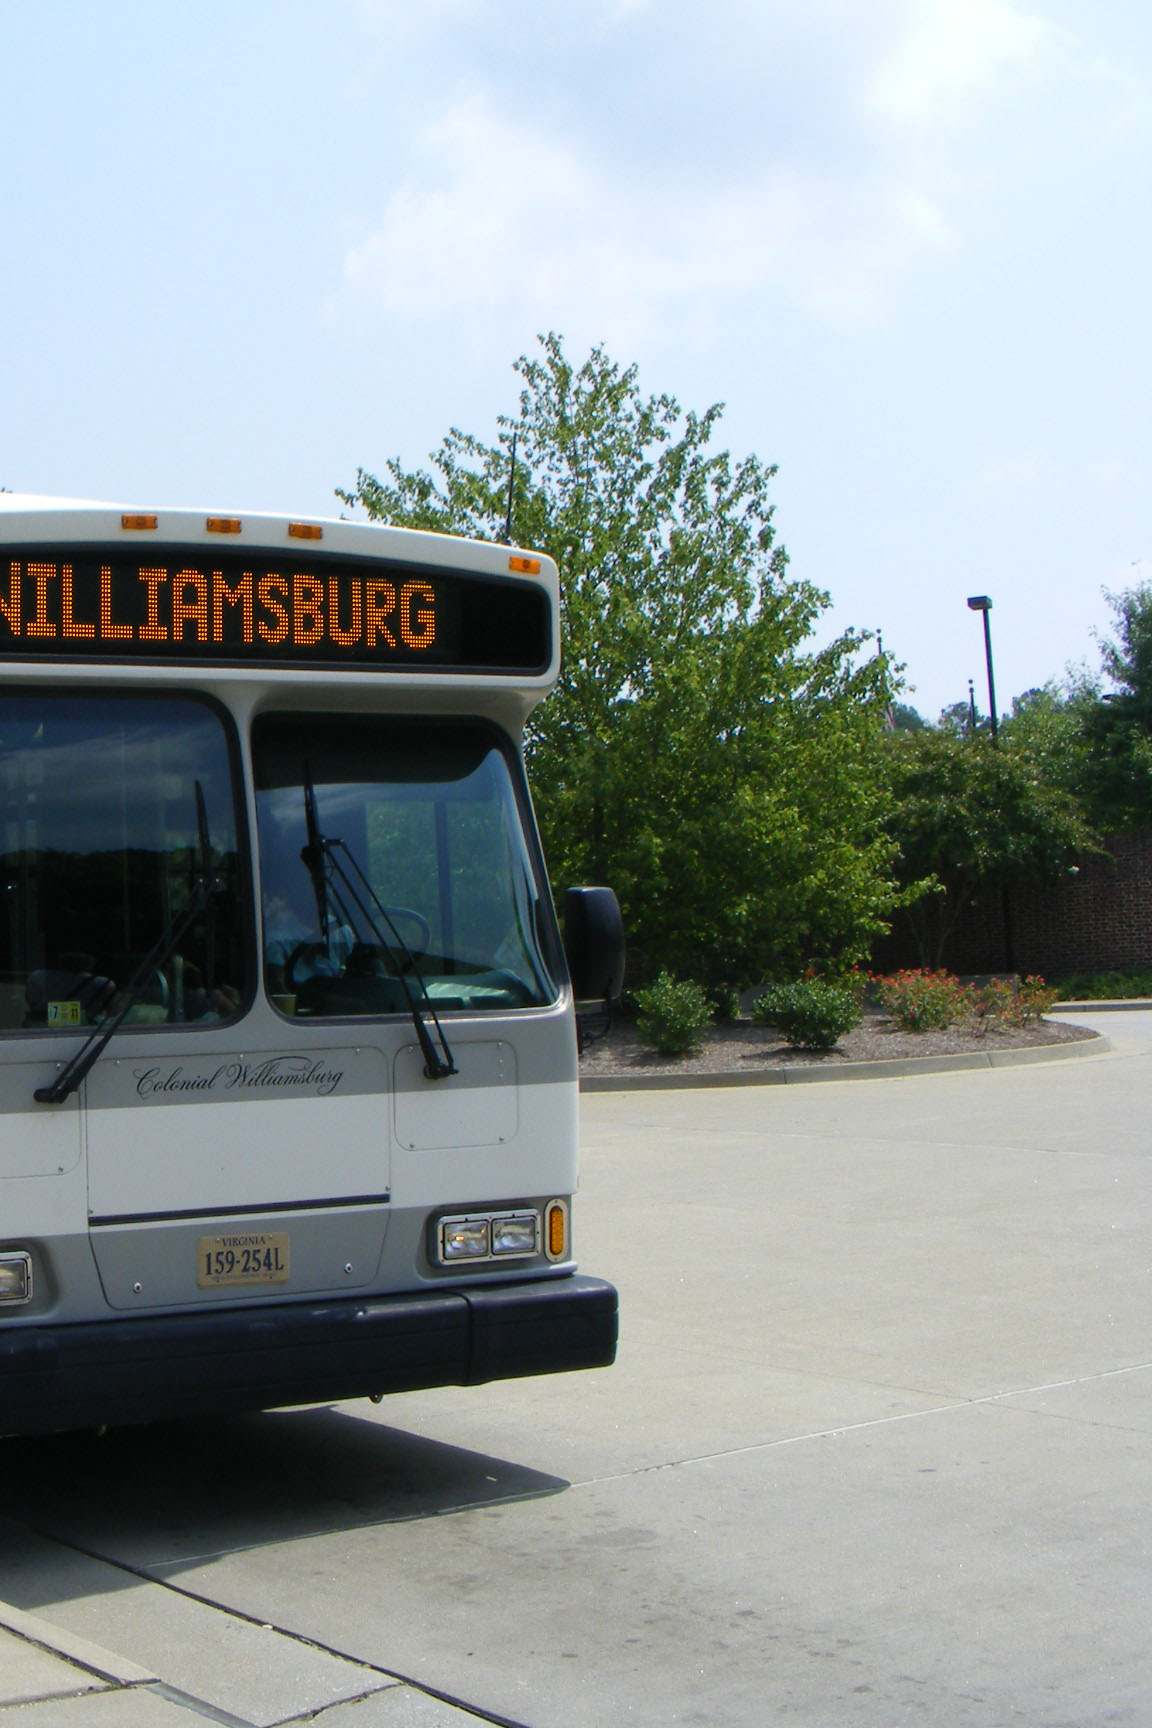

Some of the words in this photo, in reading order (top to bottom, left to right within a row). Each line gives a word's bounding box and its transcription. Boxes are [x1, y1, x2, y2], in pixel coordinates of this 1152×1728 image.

[132, 1064, 227, 1100] Colonial
[224, 1055, 345, 1097] Williamsburg
[222, 1235, 267, 1247] VIRGINIA
[205, 1247, 285, 1276] 159-254L
